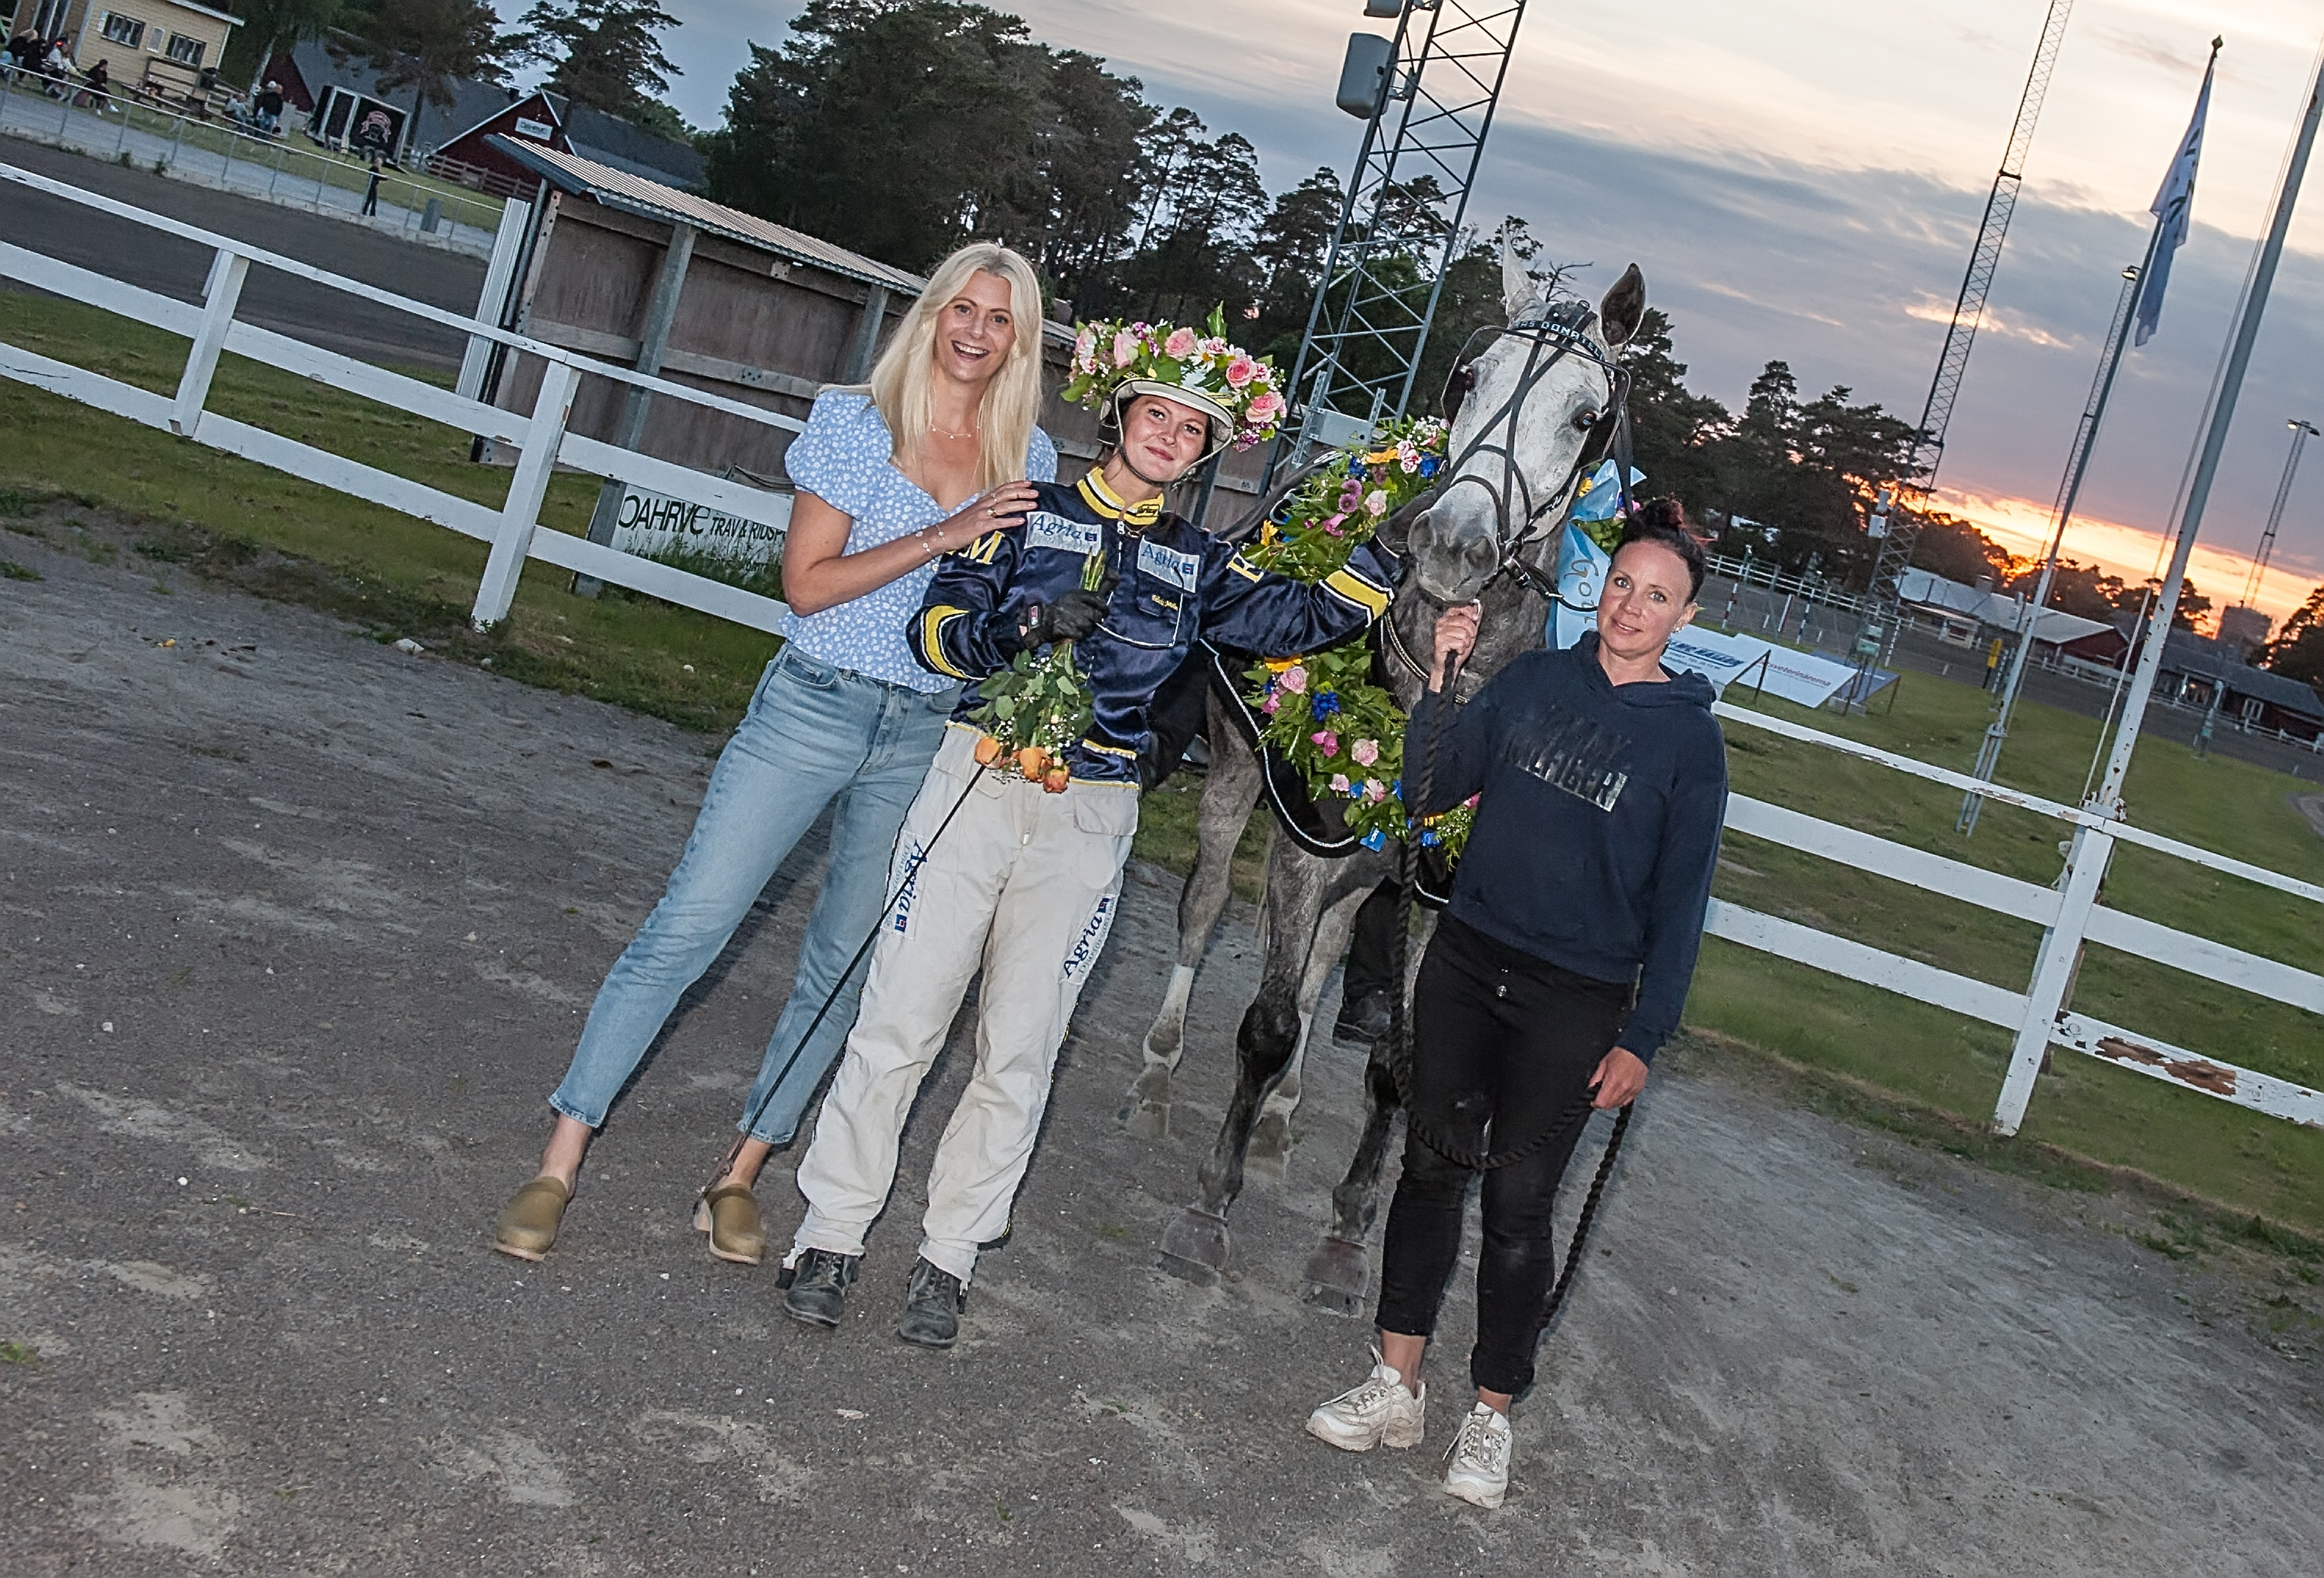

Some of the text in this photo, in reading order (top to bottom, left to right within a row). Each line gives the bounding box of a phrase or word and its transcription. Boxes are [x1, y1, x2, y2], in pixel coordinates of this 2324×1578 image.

[710, 517, 741, 538] TRAV
[739, 519, 748, 538] &
[748, 521, 786, 542] RIDSP
[1031, 514, 1083, 540] Agria
[1141, 543, 1181, 572] Agria
[1064, 915, 1103, 978] Agria
